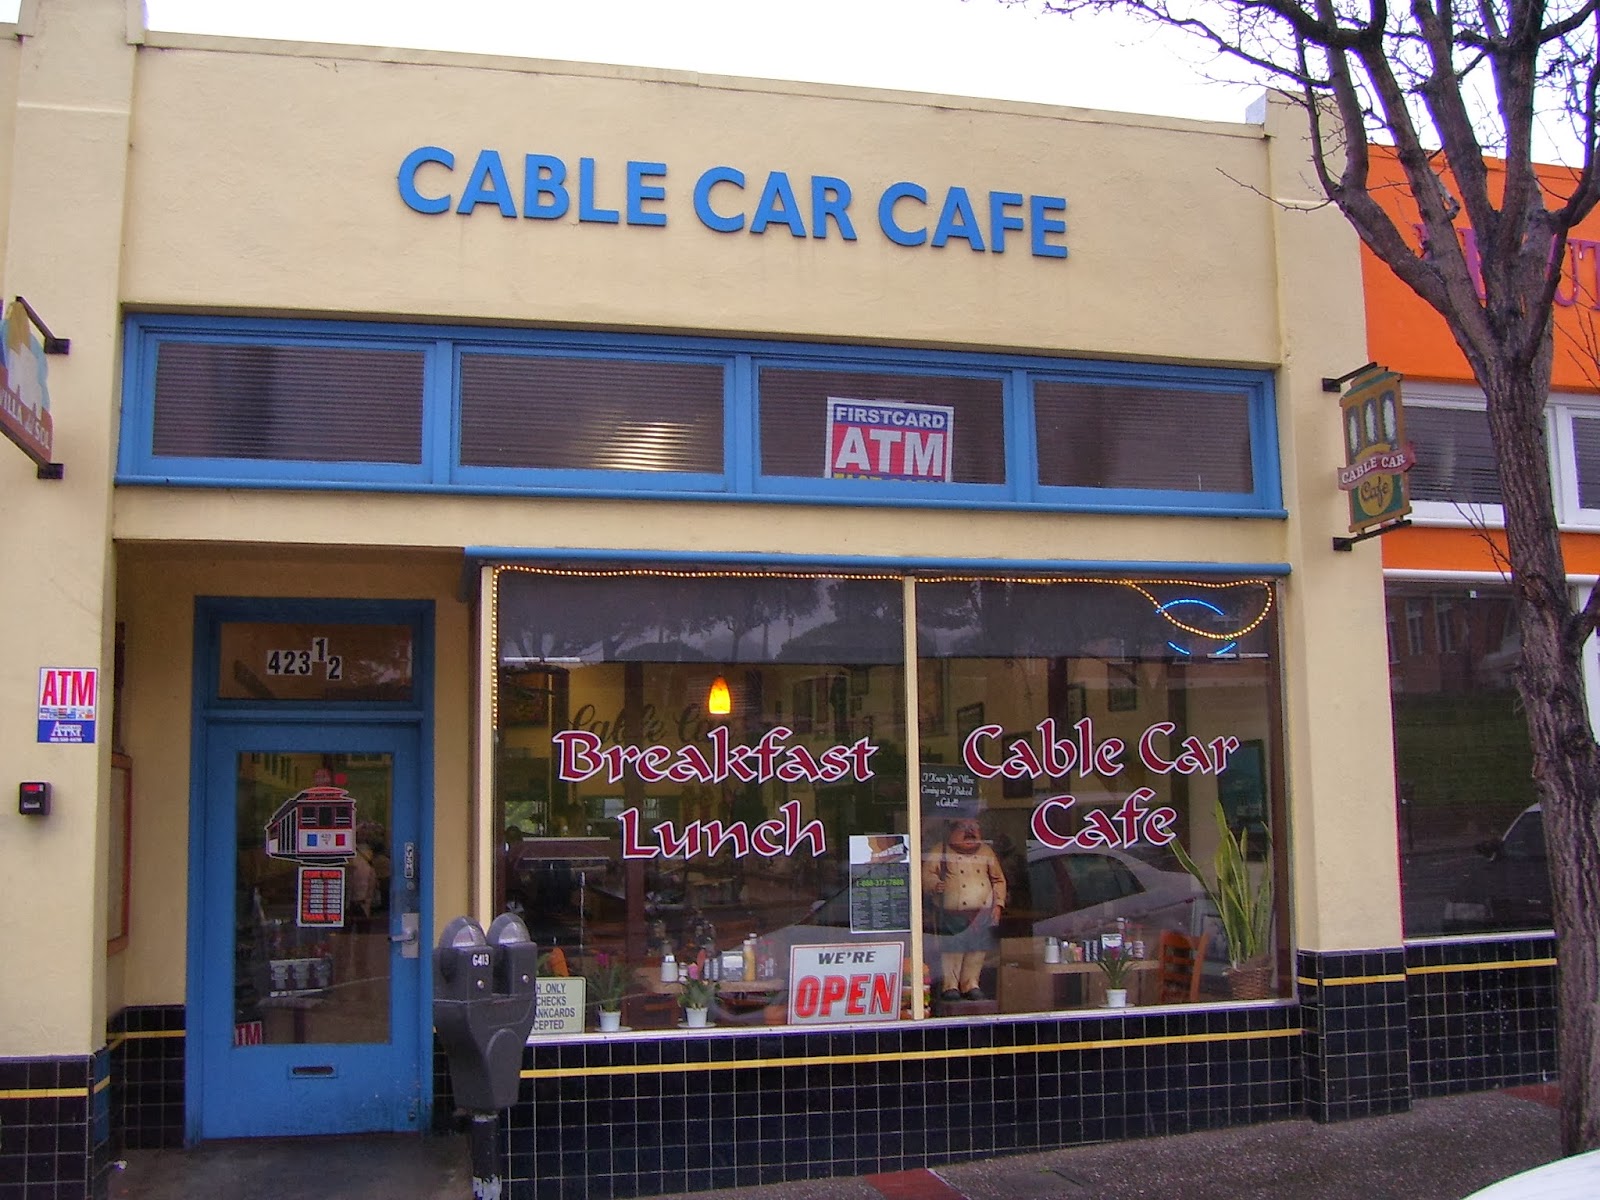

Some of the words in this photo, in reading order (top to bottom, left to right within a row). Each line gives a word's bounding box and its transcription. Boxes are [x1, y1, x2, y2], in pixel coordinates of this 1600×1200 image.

[396, 146, 668, 227] CABLE
[693, 166, 858, 241] CAR
[878, 181, 1068, 258] CAFE
[835, 406, 945, 428] FIRSTCARD
[835, 426, 943, 476] ATM
[1341, 457, 1378, 484] CABLE
[1381, 453, 1406, 469] CAR
[268, 651, 311, 675] 423
[42, 670, 95, 706] ATM
[552, 725, 879, 784] Breakfast
[963, 717, 1125, 779] Cable
[1139, 721, 1240, 775] Car
[617, 800, 827, 859] Lunch
[1031, 787, 1178, 849] Cafe
[545, 983, 566, 994] ONLY
[794, 972, 898, 1019] OPEN
[235, 1022, 262, 1047] TM
[533, 1019, 565, 1030] CEPTED
